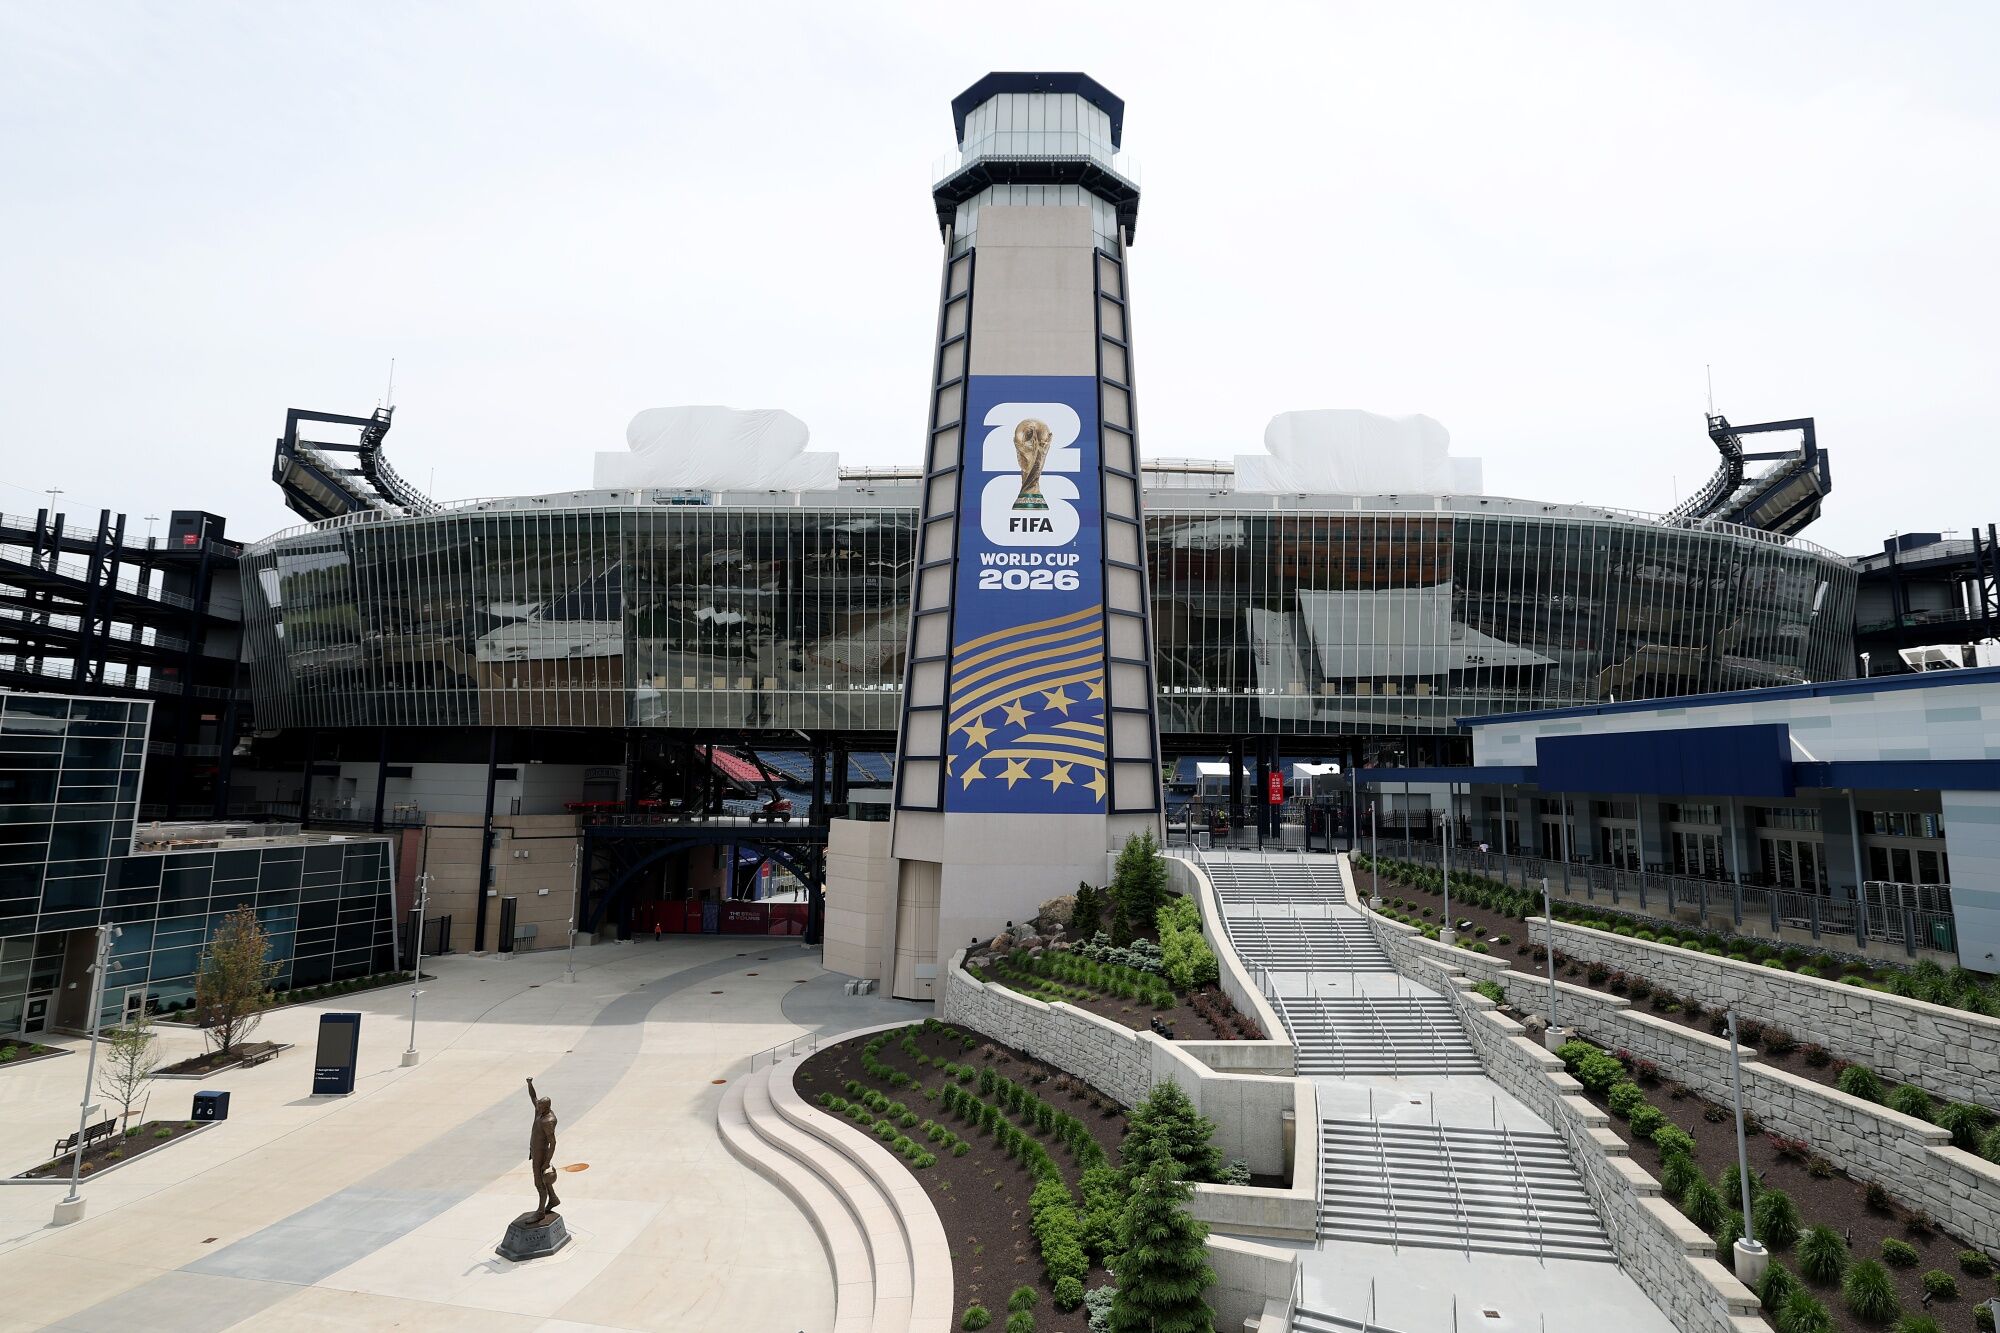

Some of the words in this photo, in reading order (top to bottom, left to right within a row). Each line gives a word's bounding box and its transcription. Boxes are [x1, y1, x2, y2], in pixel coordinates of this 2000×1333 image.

[1009, 517, 1054, 533] FIFA
[980, 553, 1042, 566] WORLD
[1045, 553, 1080, 566] CUP
[978, 569, 1080, 591] 2026
